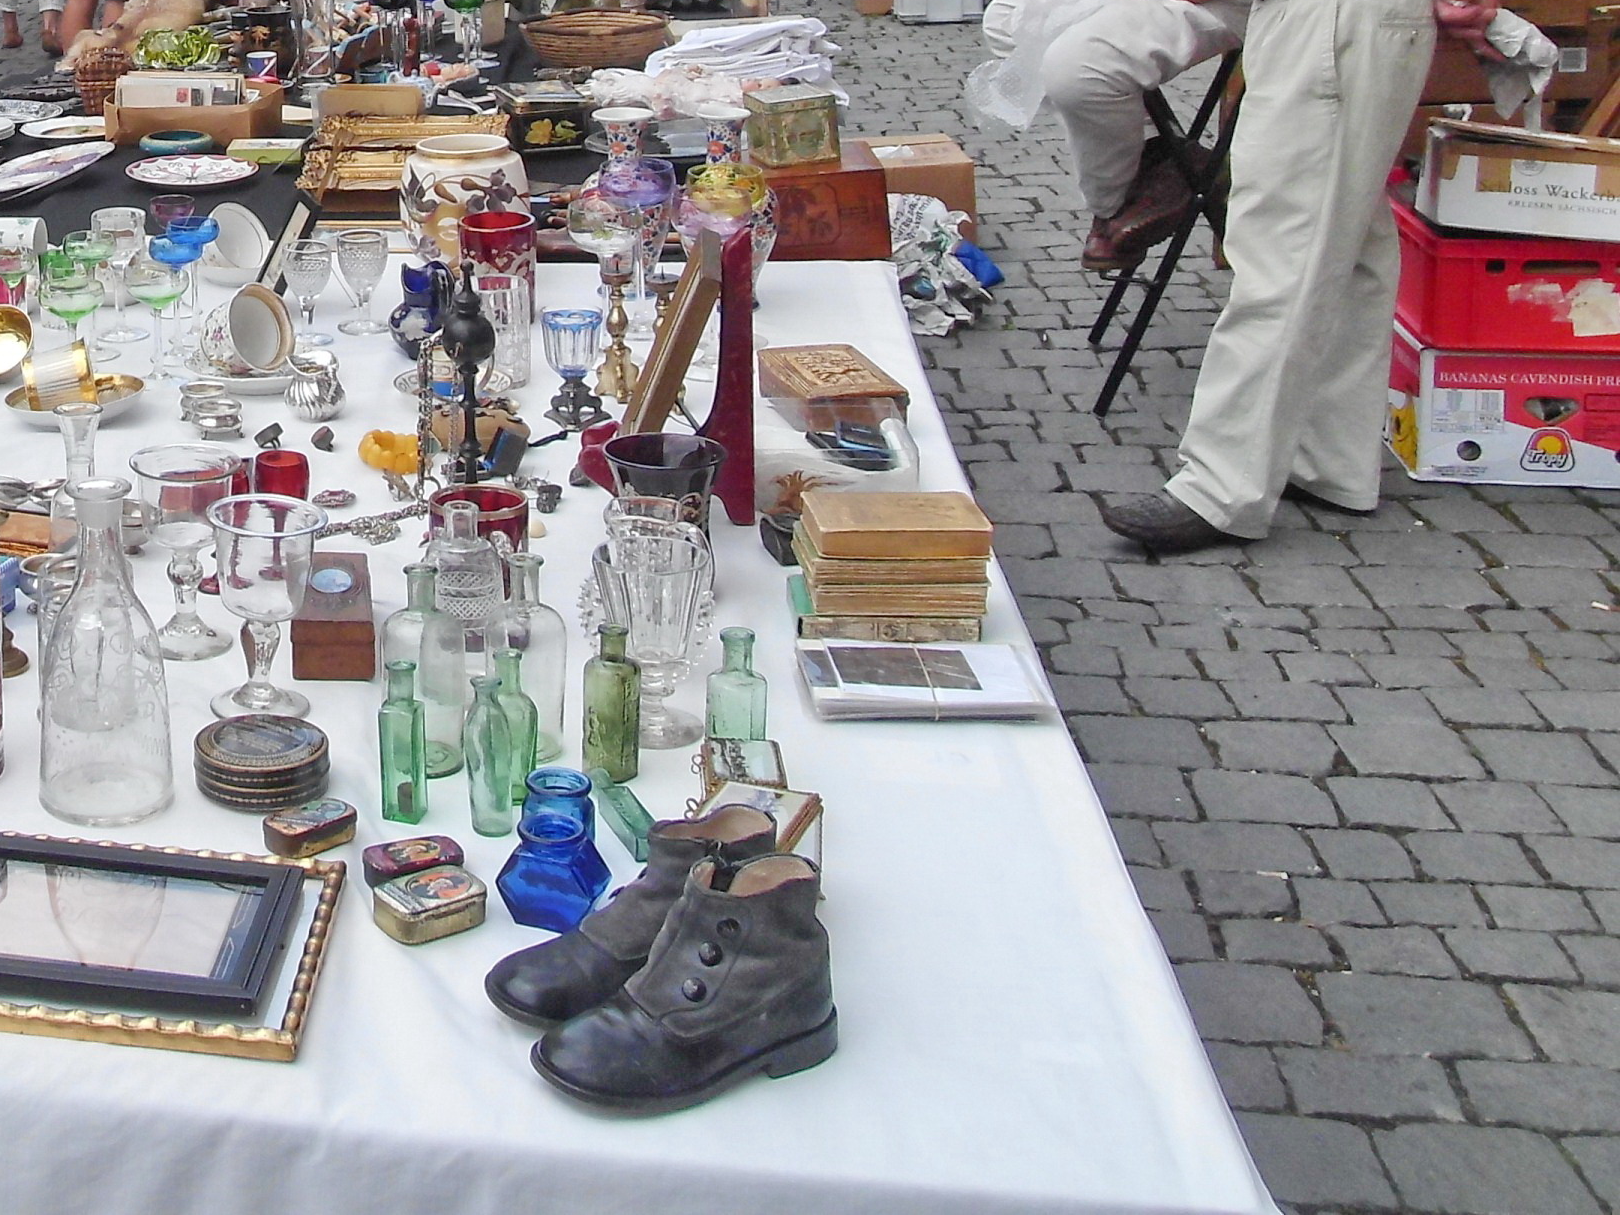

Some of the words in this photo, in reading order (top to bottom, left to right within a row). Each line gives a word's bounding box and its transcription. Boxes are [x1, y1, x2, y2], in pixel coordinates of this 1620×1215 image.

[1545, 183, 1620, 203] Wackerb
[1440, 371, 1507, 383] BANANAS
[1510, 373, 1593, 385] CAVENDISH
[1526, 448, 1567, 468] Tropy
